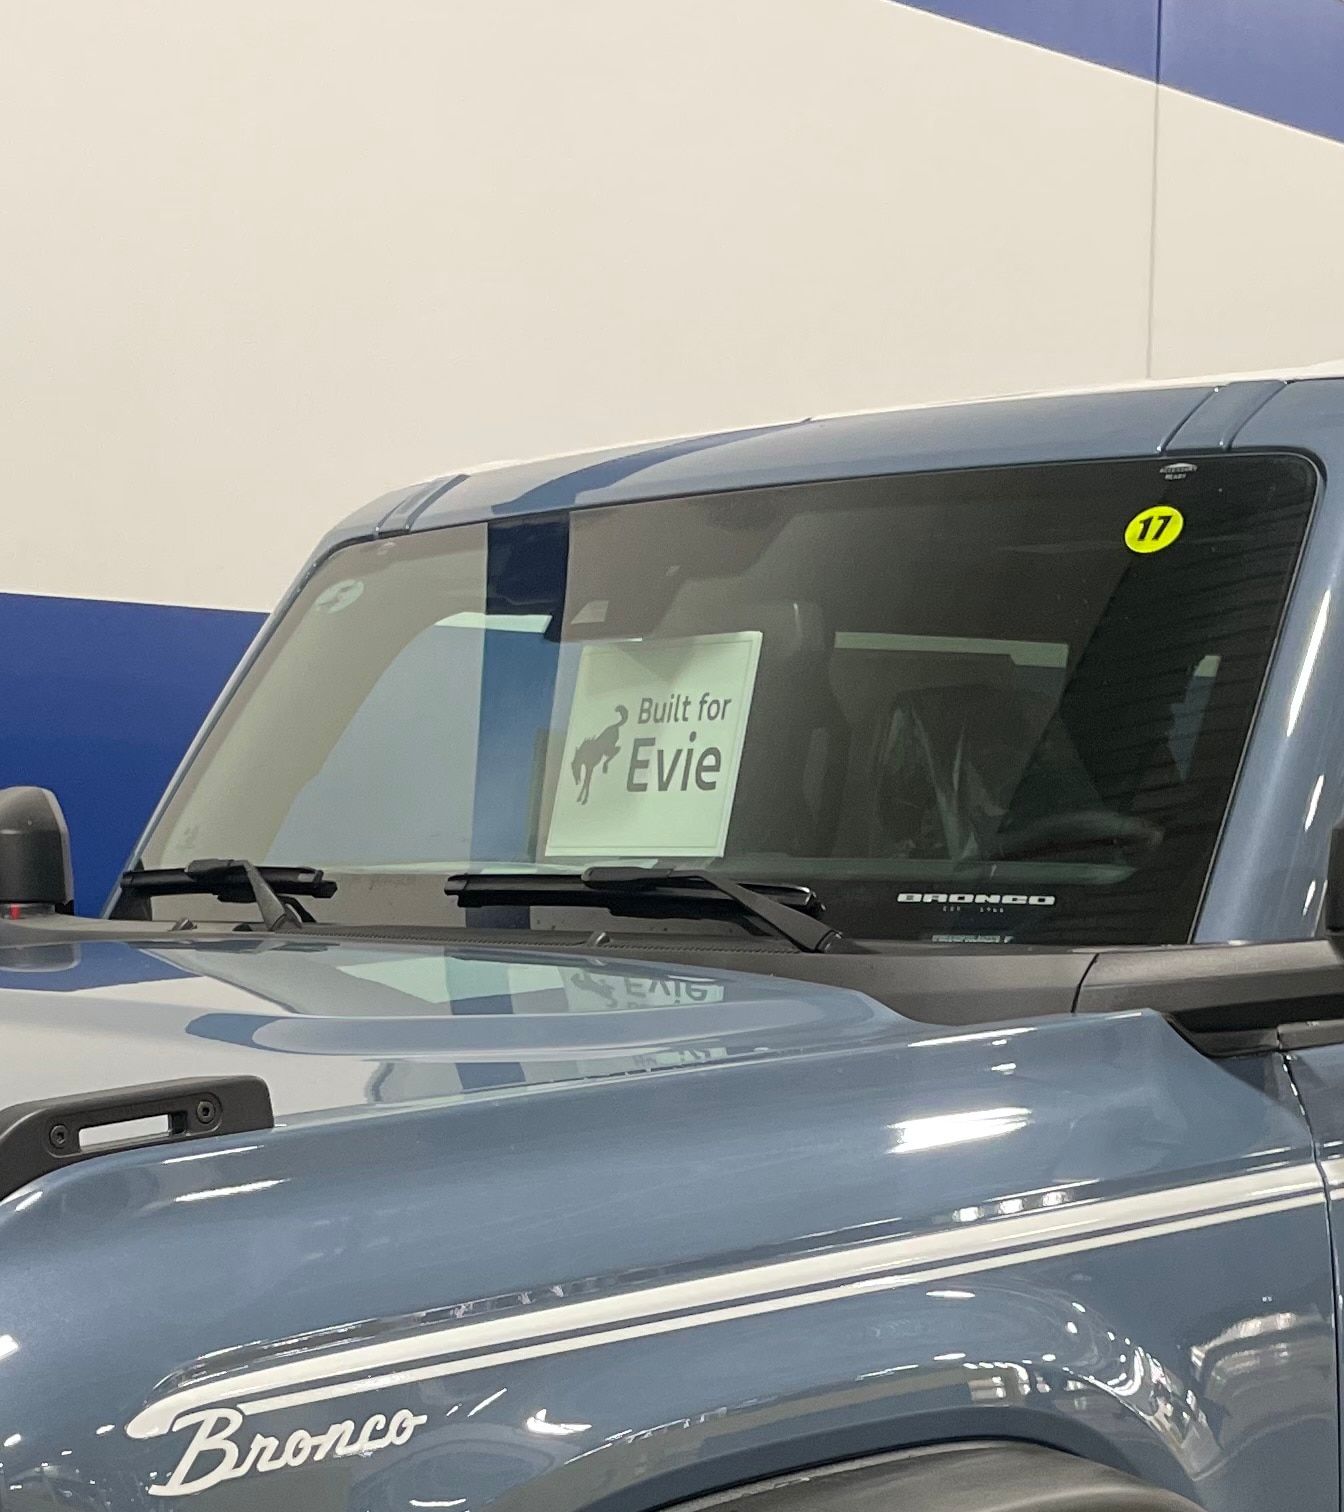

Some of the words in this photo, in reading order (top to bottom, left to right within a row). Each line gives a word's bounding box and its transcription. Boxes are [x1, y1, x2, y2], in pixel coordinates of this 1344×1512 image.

[1137, 514, 1173, 541] 17
[637, 693, 692, 725] Built
[697, 692, 733, 721] for
[626, 730, 722, 793] Evie
[896, 893, 1056, 905] BRONCO
[148, 1407, 429, 1497] Bronco
